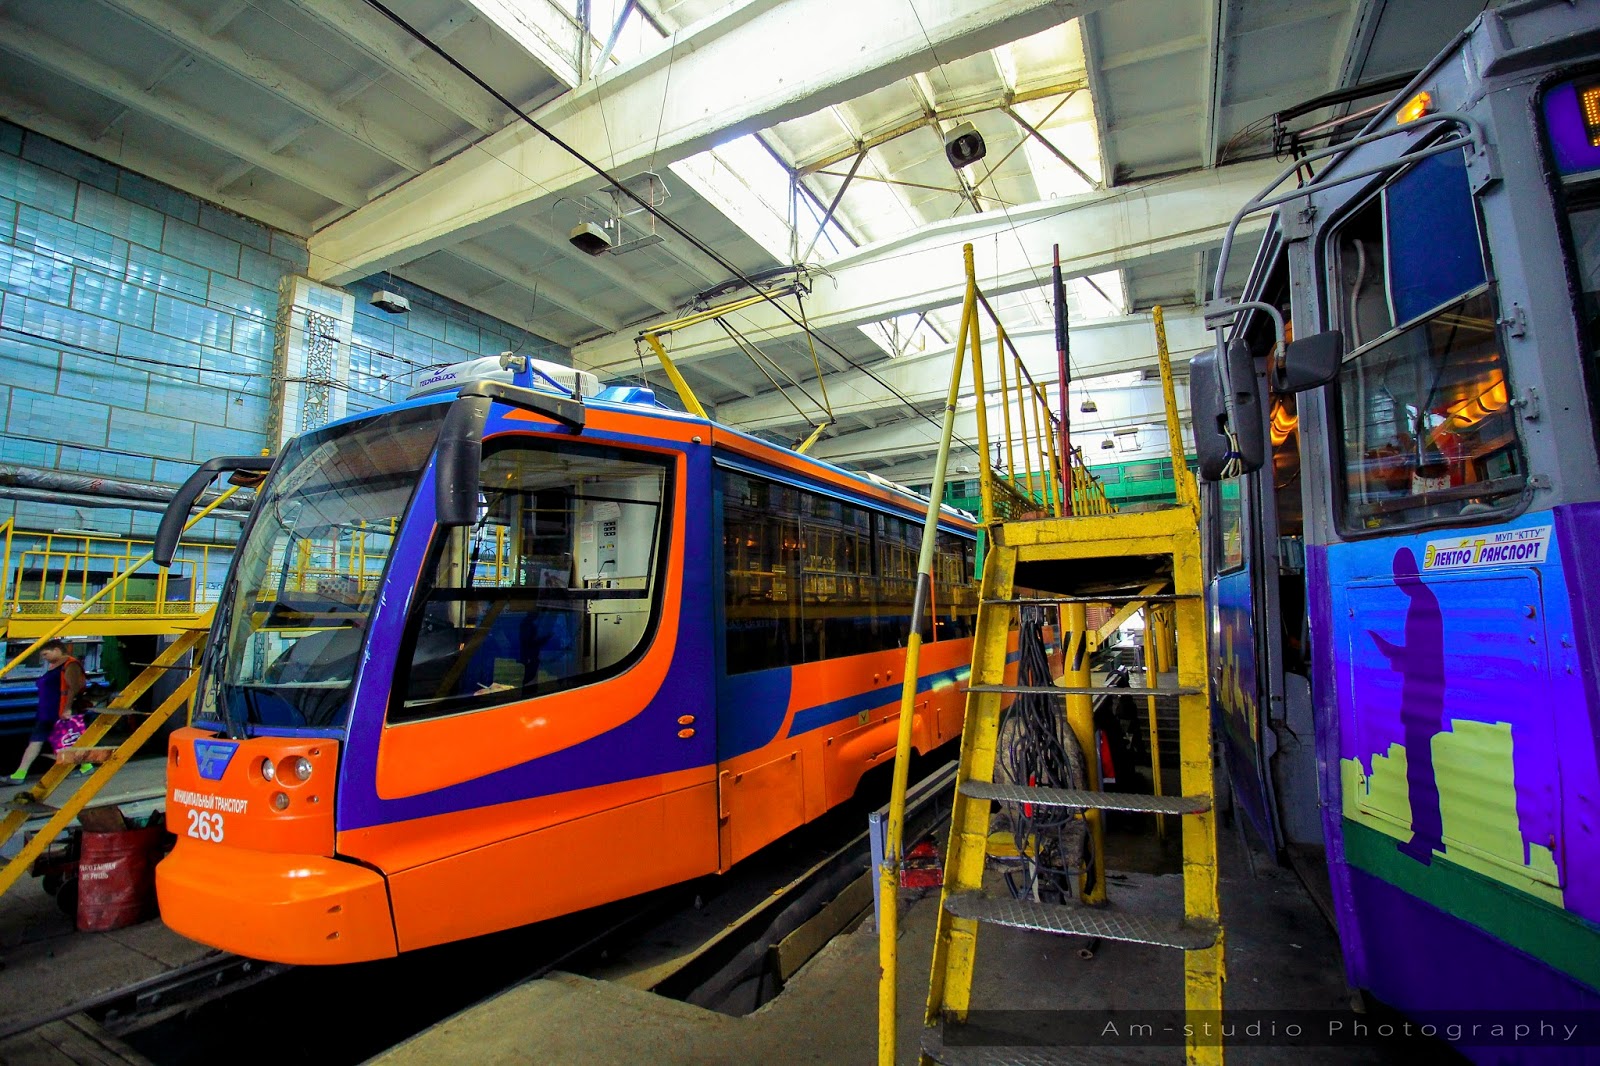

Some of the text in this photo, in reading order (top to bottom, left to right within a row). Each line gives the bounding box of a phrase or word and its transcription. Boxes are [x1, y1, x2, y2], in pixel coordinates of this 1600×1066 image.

[1495, 532, 1513, 542] МУП
[174, 788, 248, 814] МУНИЦИПАЛЬНЫЙ ТРАНСПОРТ
[187, 809, 224, 843] 263
